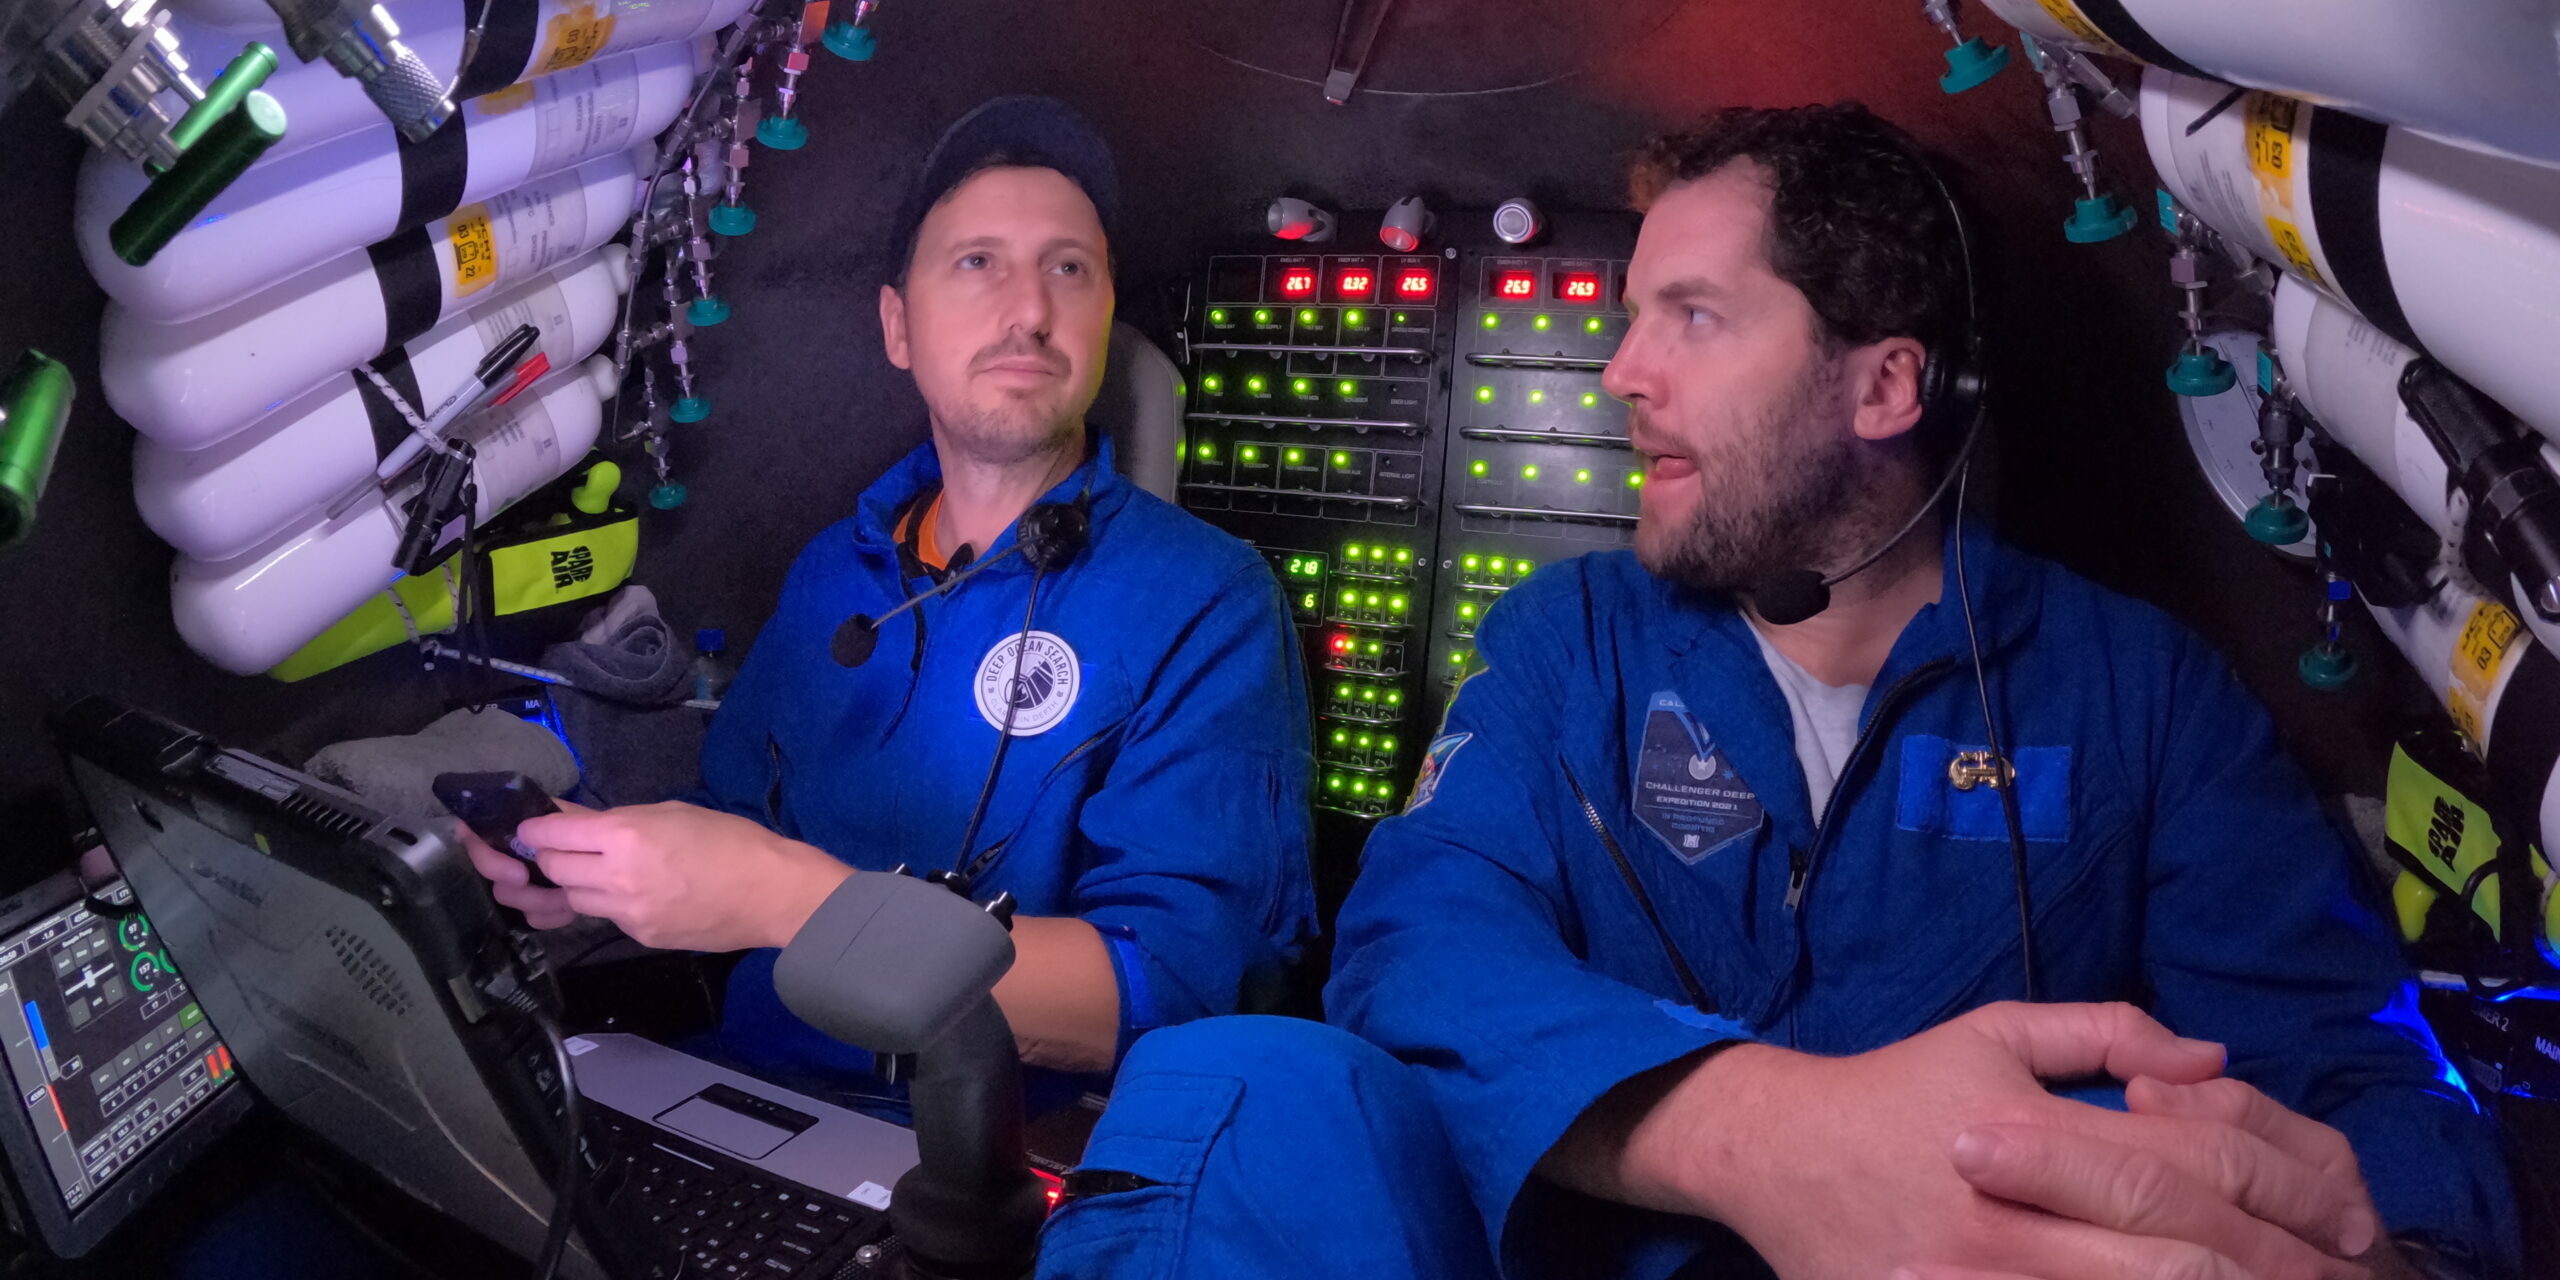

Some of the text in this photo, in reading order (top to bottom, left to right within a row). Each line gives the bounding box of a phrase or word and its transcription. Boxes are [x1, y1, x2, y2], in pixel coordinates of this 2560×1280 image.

[457, 224, 469, 239] 03
[550, 550, 574, 589] AIR
[569, 545, 594, 583] SPARE
[1304, 593, 1314, 608] 6
[986, 654, 1005, 682] DEEP
[1044, 645, 1069, 685] SEARCH
[2477, 646, 2492, 671] 03
[1645, 781, 1756, 800] CHALLENGER DEEP
[1656, 796, 1739, 811] EXPEDITION 2021
[2428, 795, 2453, 858] SPARE
[2440, 804, 2465, 873] AIR
